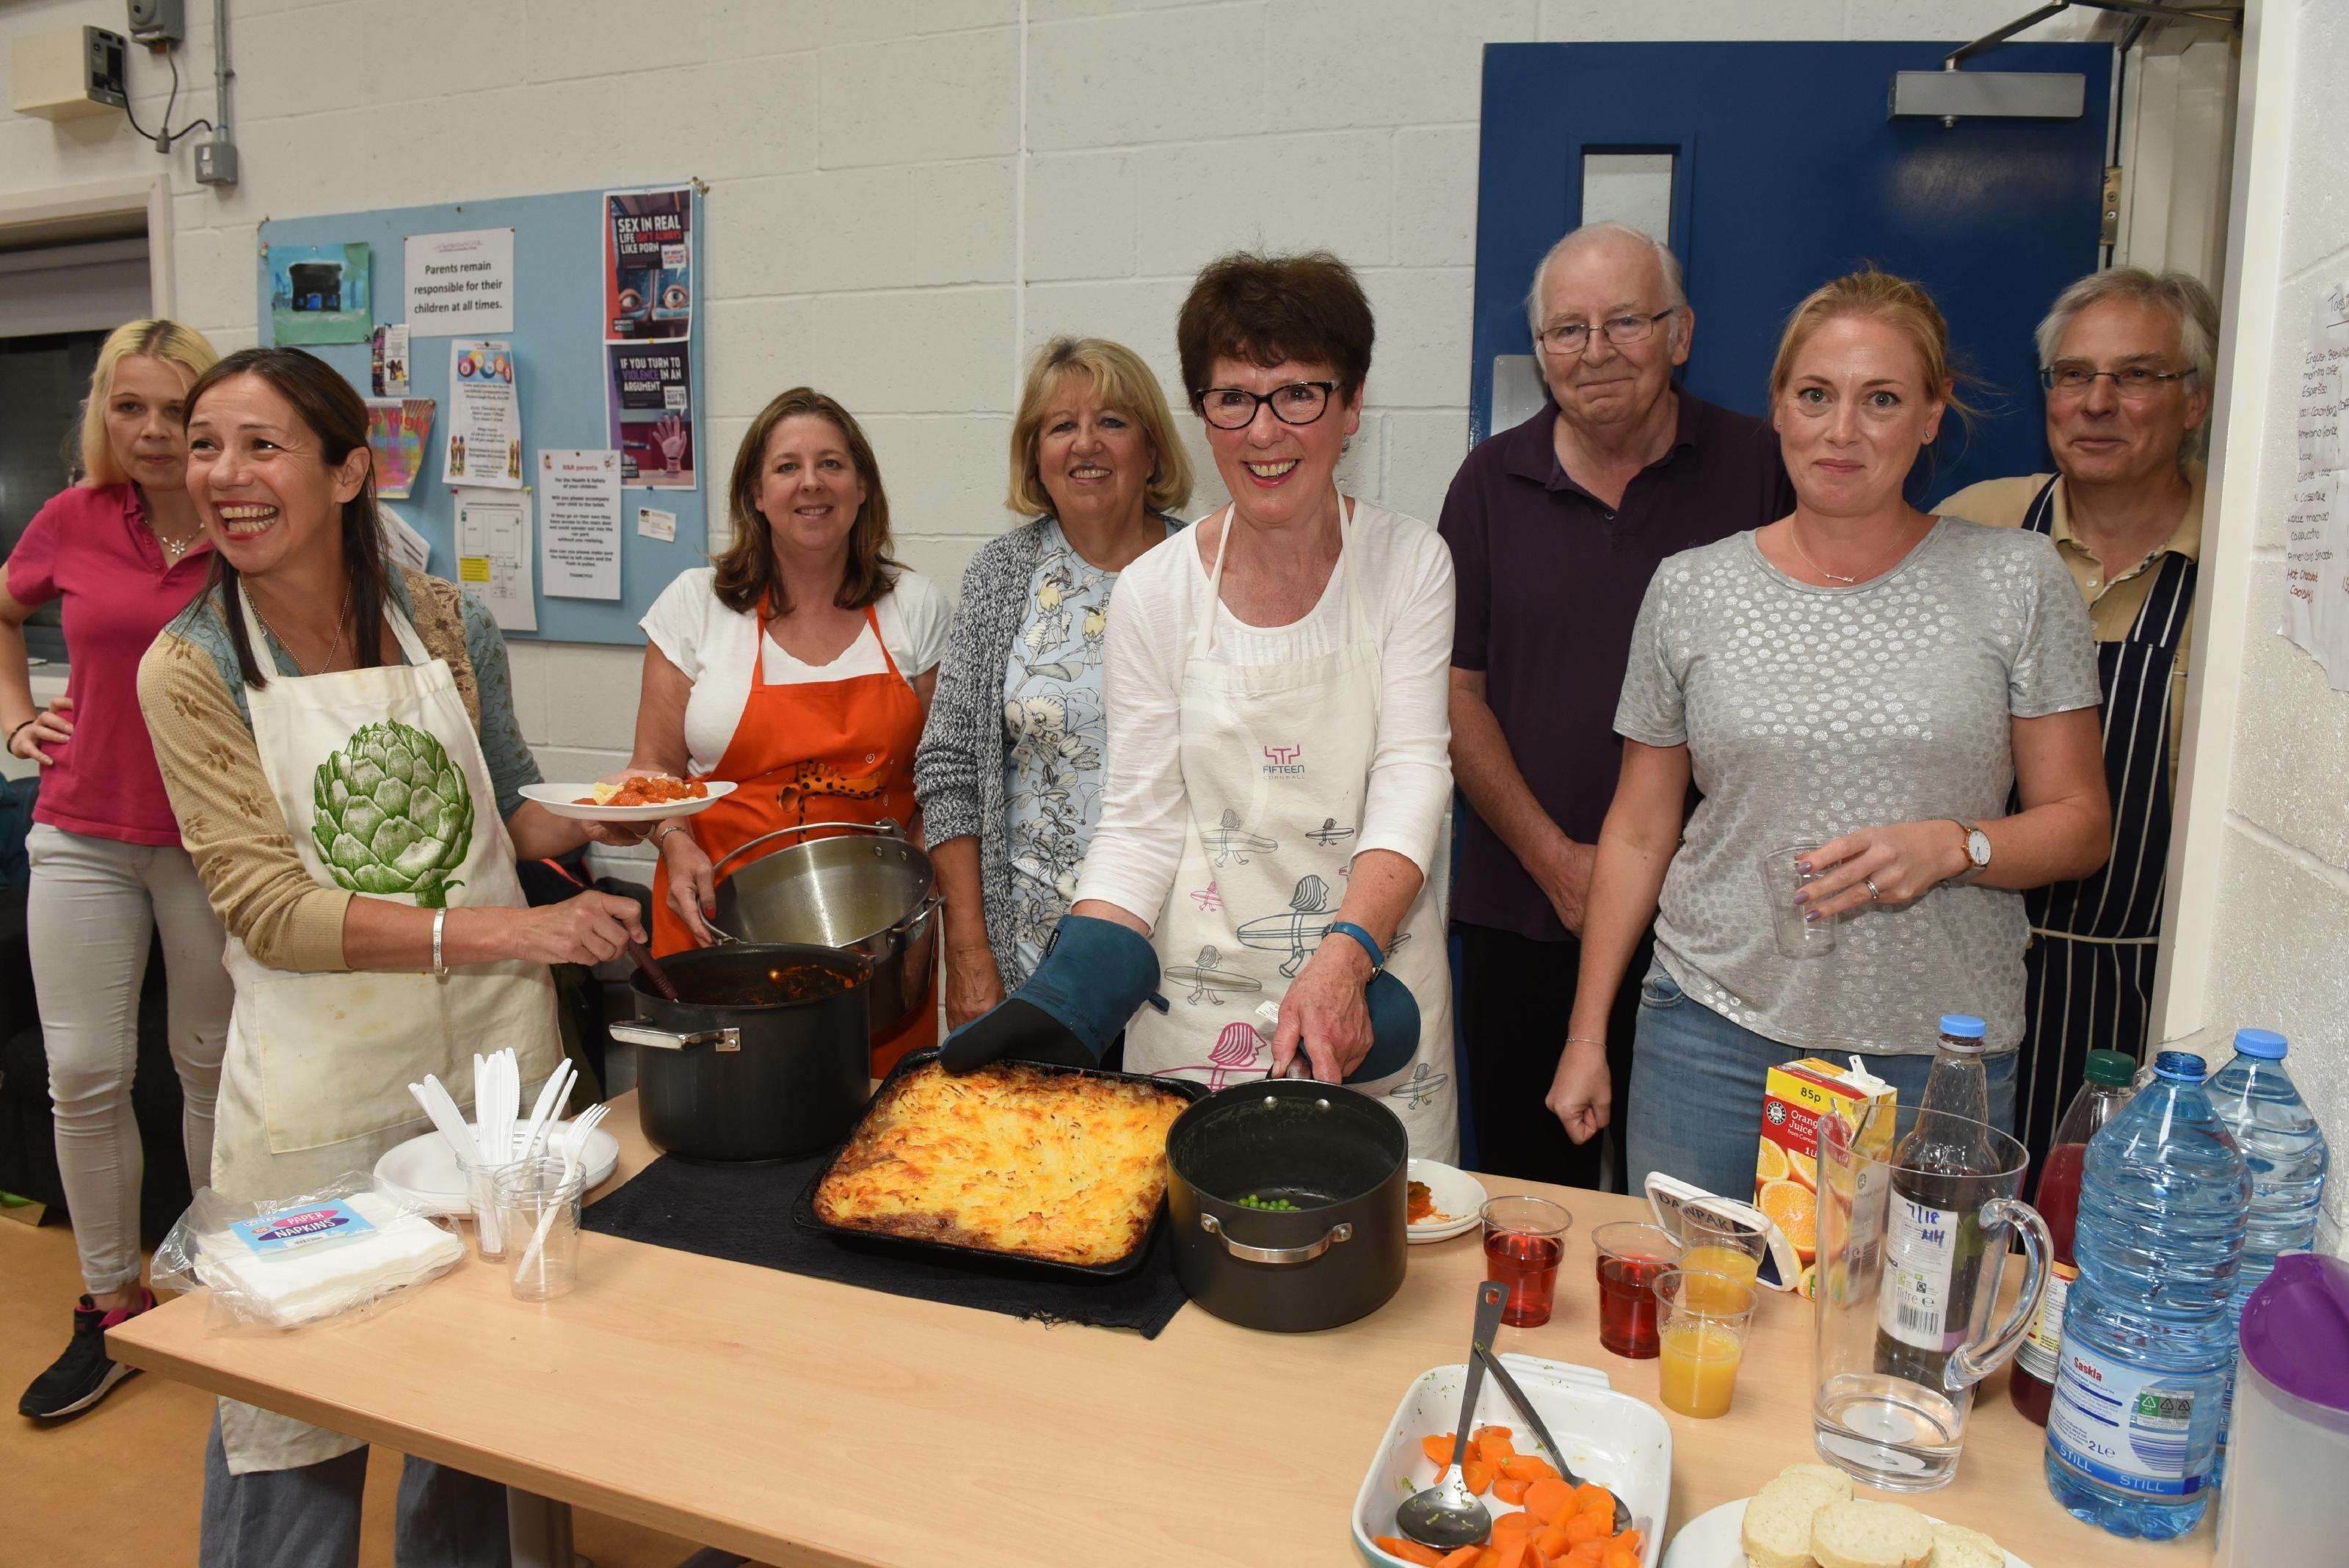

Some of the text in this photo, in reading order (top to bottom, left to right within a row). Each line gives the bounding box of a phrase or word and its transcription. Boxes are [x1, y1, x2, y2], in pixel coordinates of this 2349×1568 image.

[617, 214, 681, 233] SEX IN REAL
[620, 232, 635, 244] LIFE
[621, 242, 659, 254] LIKE PORN
[425, 261, 491, 275] Parents remain
[414, 279, 503, 296] responsible for their
[414, 300, 502, 314] children at all times.
[620, 357, 680, 369] IF YOU TURN TO
[622, 369, 682, 381] VIOLENCE IN AN
[623, 382, 661, 392] ARGUMENT
[1263, 765, 1305, 774] FIFTEEN
[1801, 1086, 1821, 1103] 85p
[1790, 1109, 1818, 1130] Orang
[1789, 1120, 1814, 1136] Juice
[1787, 1128, 1818, 1145] from Concen
[287, 1212, 324, 1225] PAPER
[275, 1219, 336, 1238] NAPKINS
[2074, 1357, 2102, 1382] Saskia
[2060, 1445, 2093, 1473] STILL
[2119, 1475, 2165, 1492] STILL
